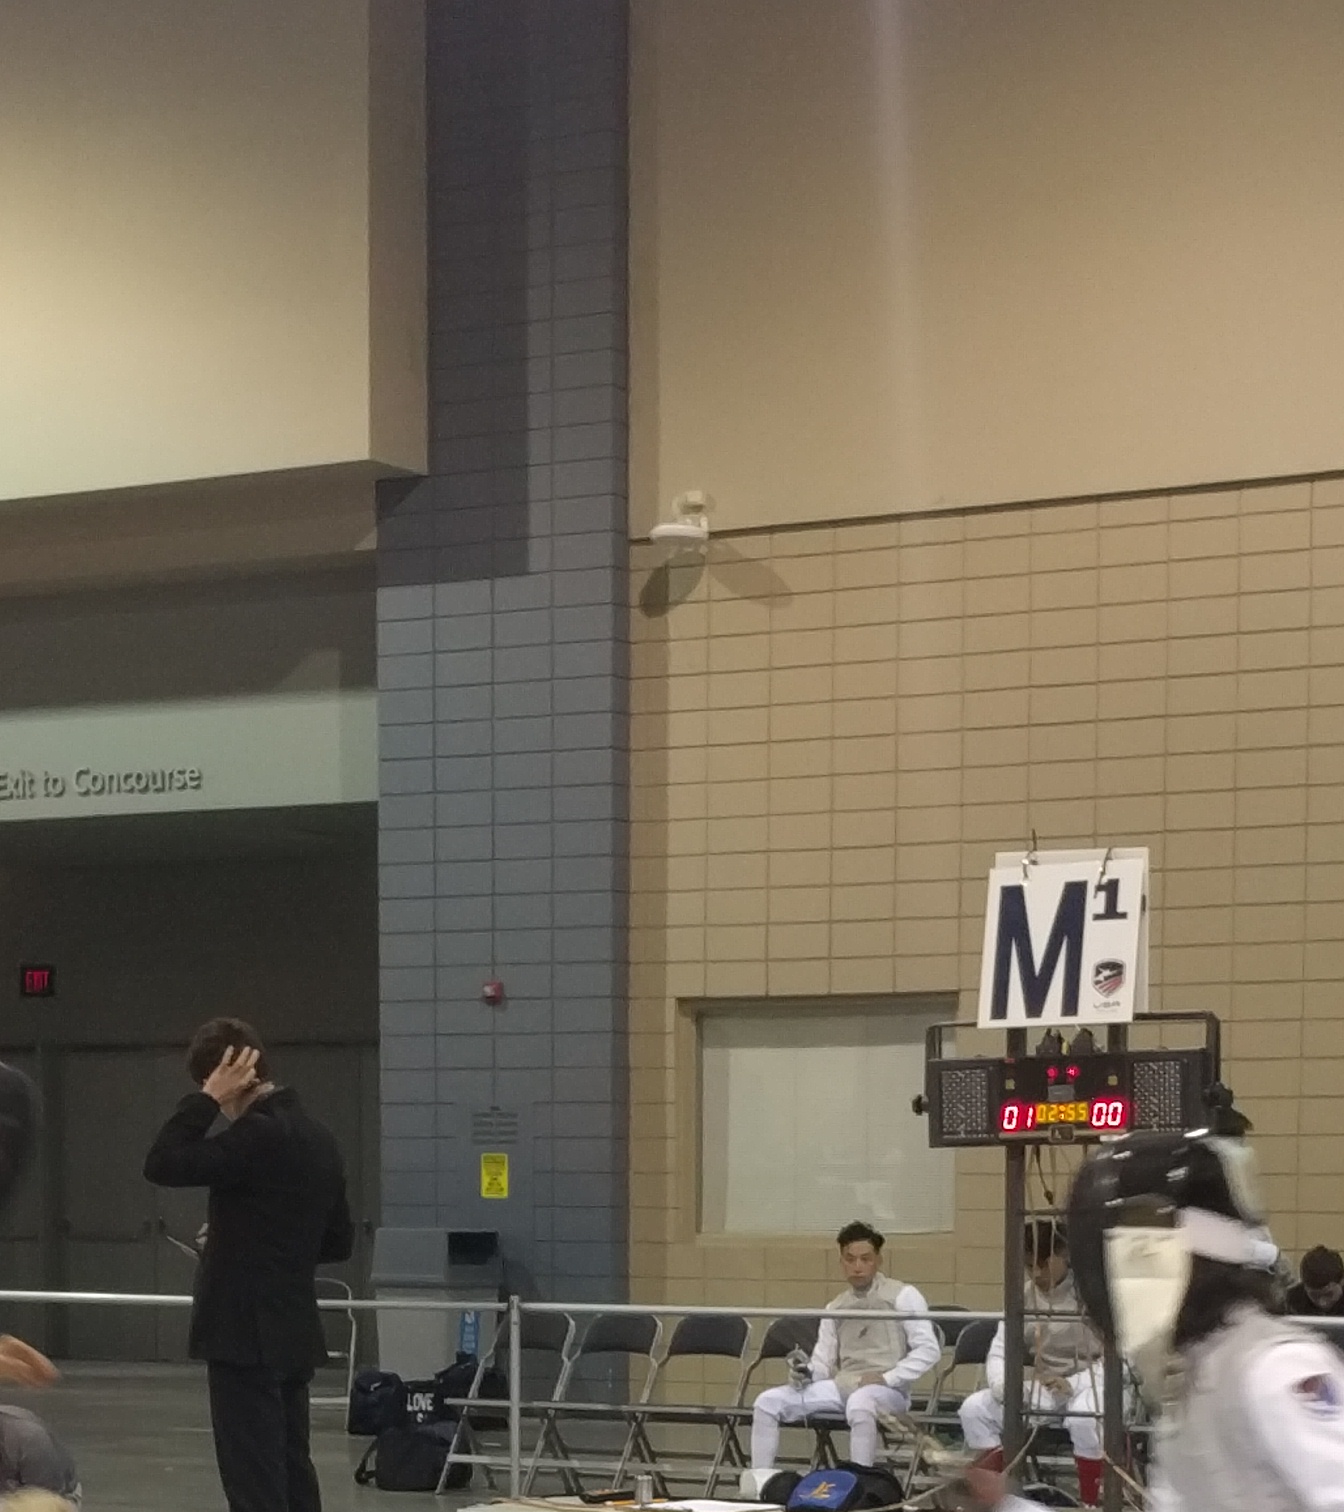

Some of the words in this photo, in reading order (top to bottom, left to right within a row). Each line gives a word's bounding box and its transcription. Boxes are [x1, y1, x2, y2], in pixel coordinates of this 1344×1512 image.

[44, 771, 67, 798] to
[74, 767, 203, 797] Concourse
[989, 879, 1089, 1021] M
[1092, 877, 1128, 921] 1
[1002, 1105, 1034, 1130] 01
[1037, 1102, 1088, 1123] 02:55
[1091, 1101, 1123, 1127] 00
[406, 1392, 435, 1412] LOVE
